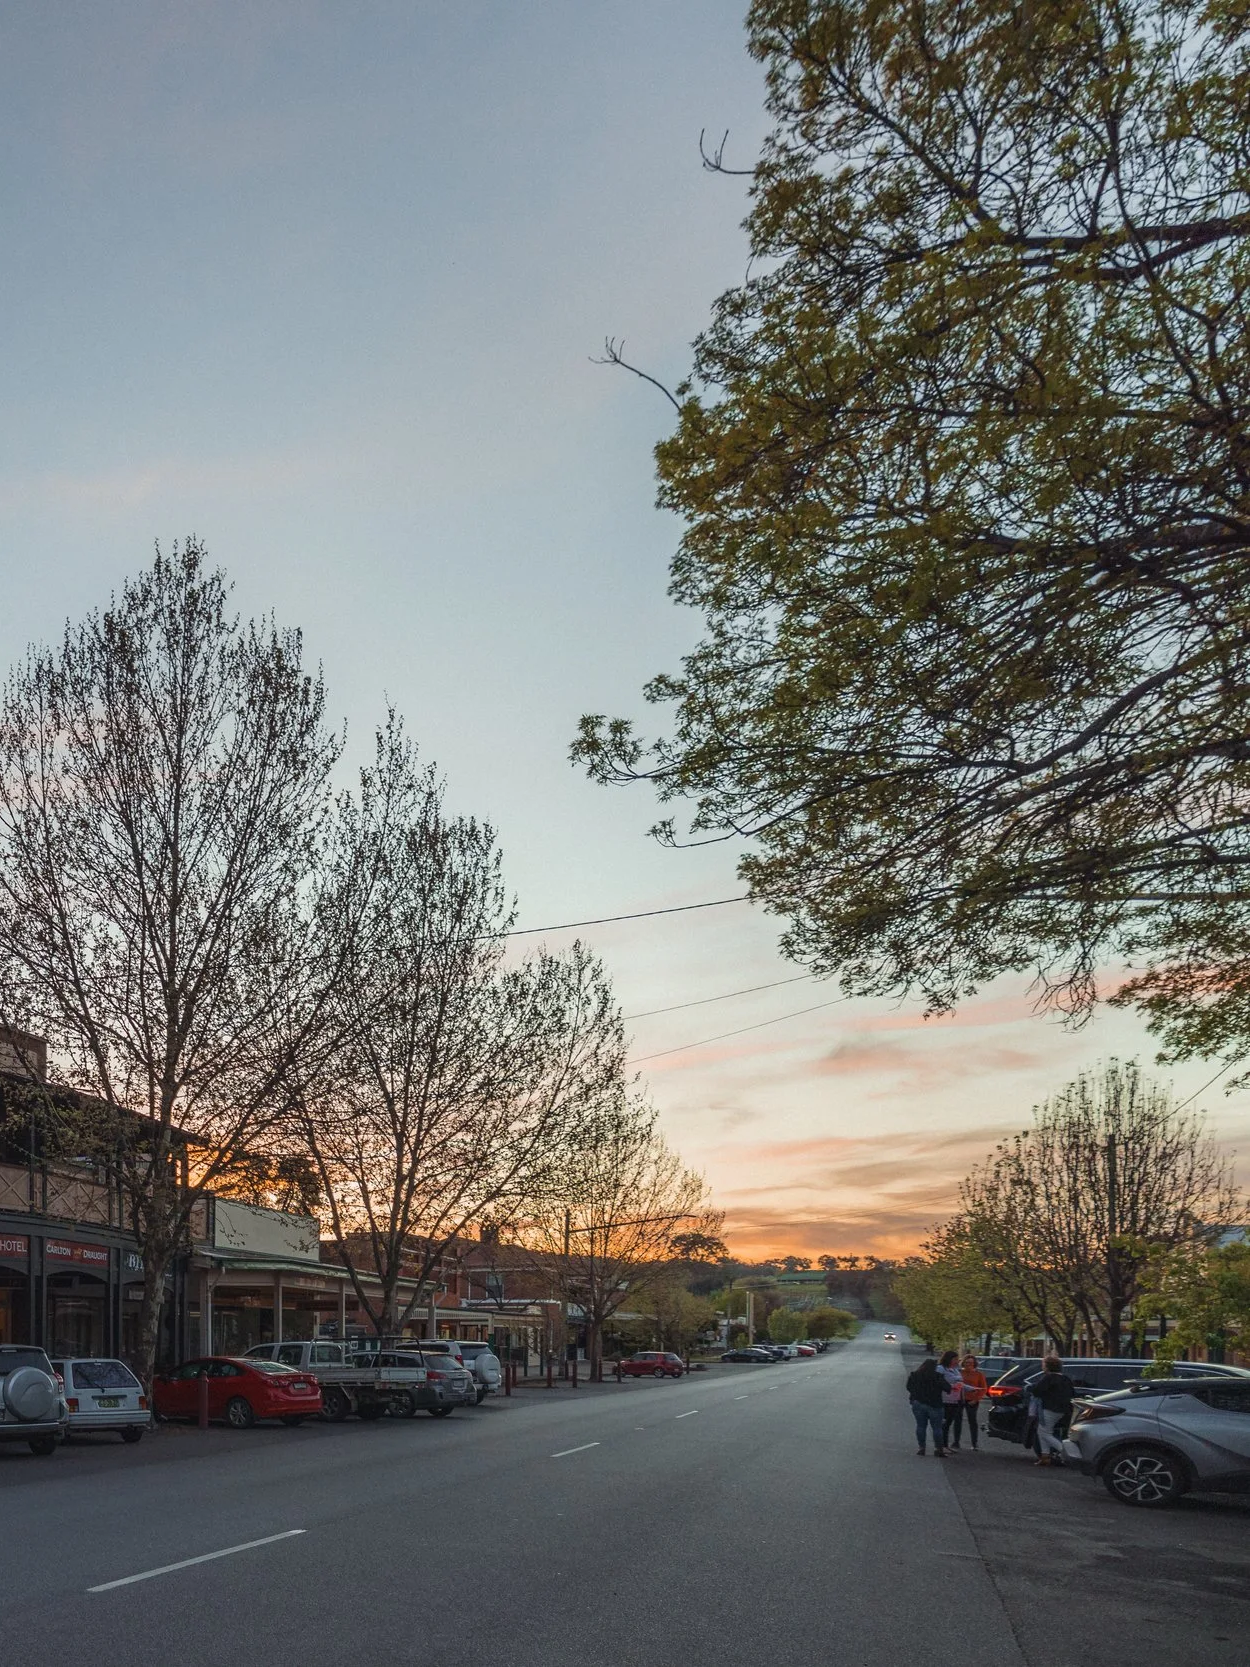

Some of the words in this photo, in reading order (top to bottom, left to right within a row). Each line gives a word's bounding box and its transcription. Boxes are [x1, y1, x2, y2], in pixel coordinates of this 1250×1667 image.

[0, 1239, 28, 1253] HOTEL
[46, 1244, 71, 1256] CARLTON
[83, 1249, 108, 1261] DRAUGHT
